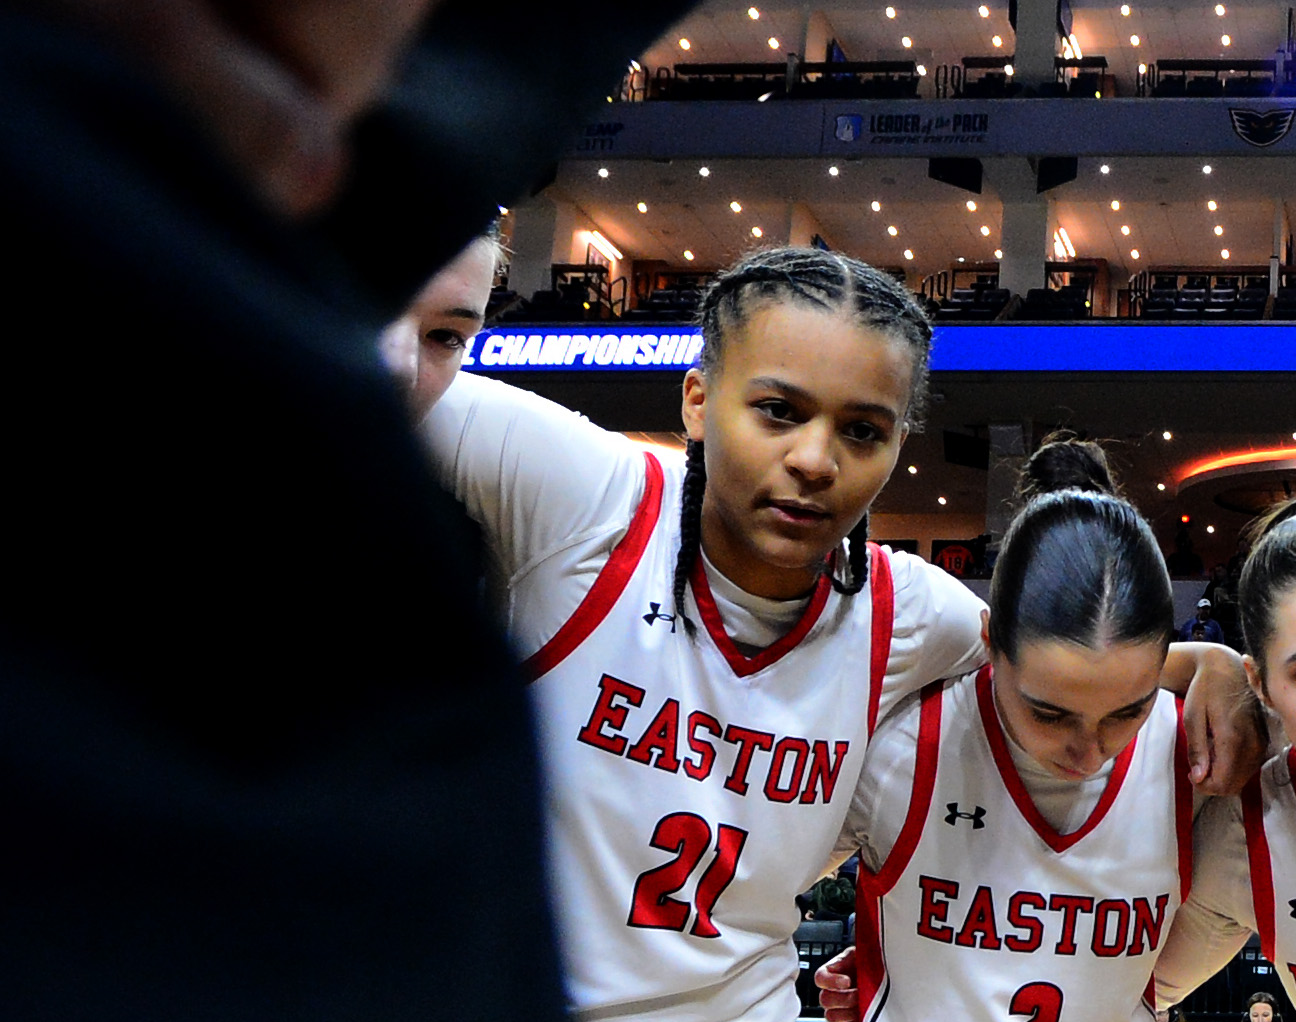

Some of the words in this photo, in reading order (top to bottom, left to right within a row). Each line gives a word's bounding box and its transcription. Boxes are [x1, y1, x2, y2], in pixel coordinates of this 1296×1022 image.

[869, 114, 920, 133] LEADER
[953, 114, 989, 133] PACK
[577, 673, 849, 805] EASTON
[626, 811, 748, 939] 21
[916, 875, 1169, 958] EASTON
